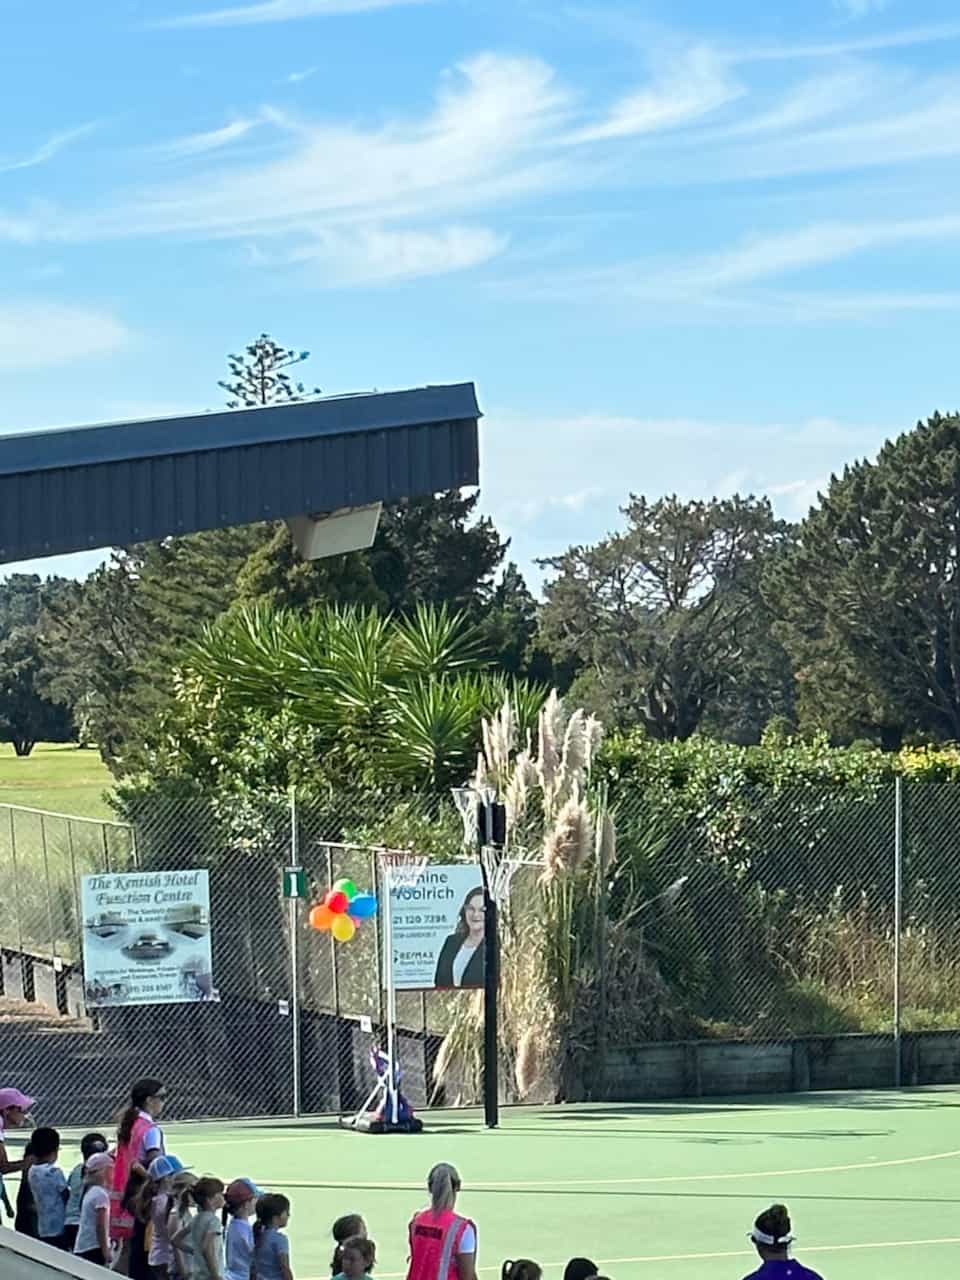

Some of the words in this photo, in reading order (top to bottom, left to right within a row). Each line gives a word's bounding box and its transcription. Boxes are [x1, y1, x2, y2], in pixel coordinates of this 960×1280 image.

[89, 876, 113, 890] The
[114, 874, 161, 891] Kentish
[163, 871, 200, 887] Hotel
[96, 892, 151, 905] Function
[153, 889, 193, 904] Centre
